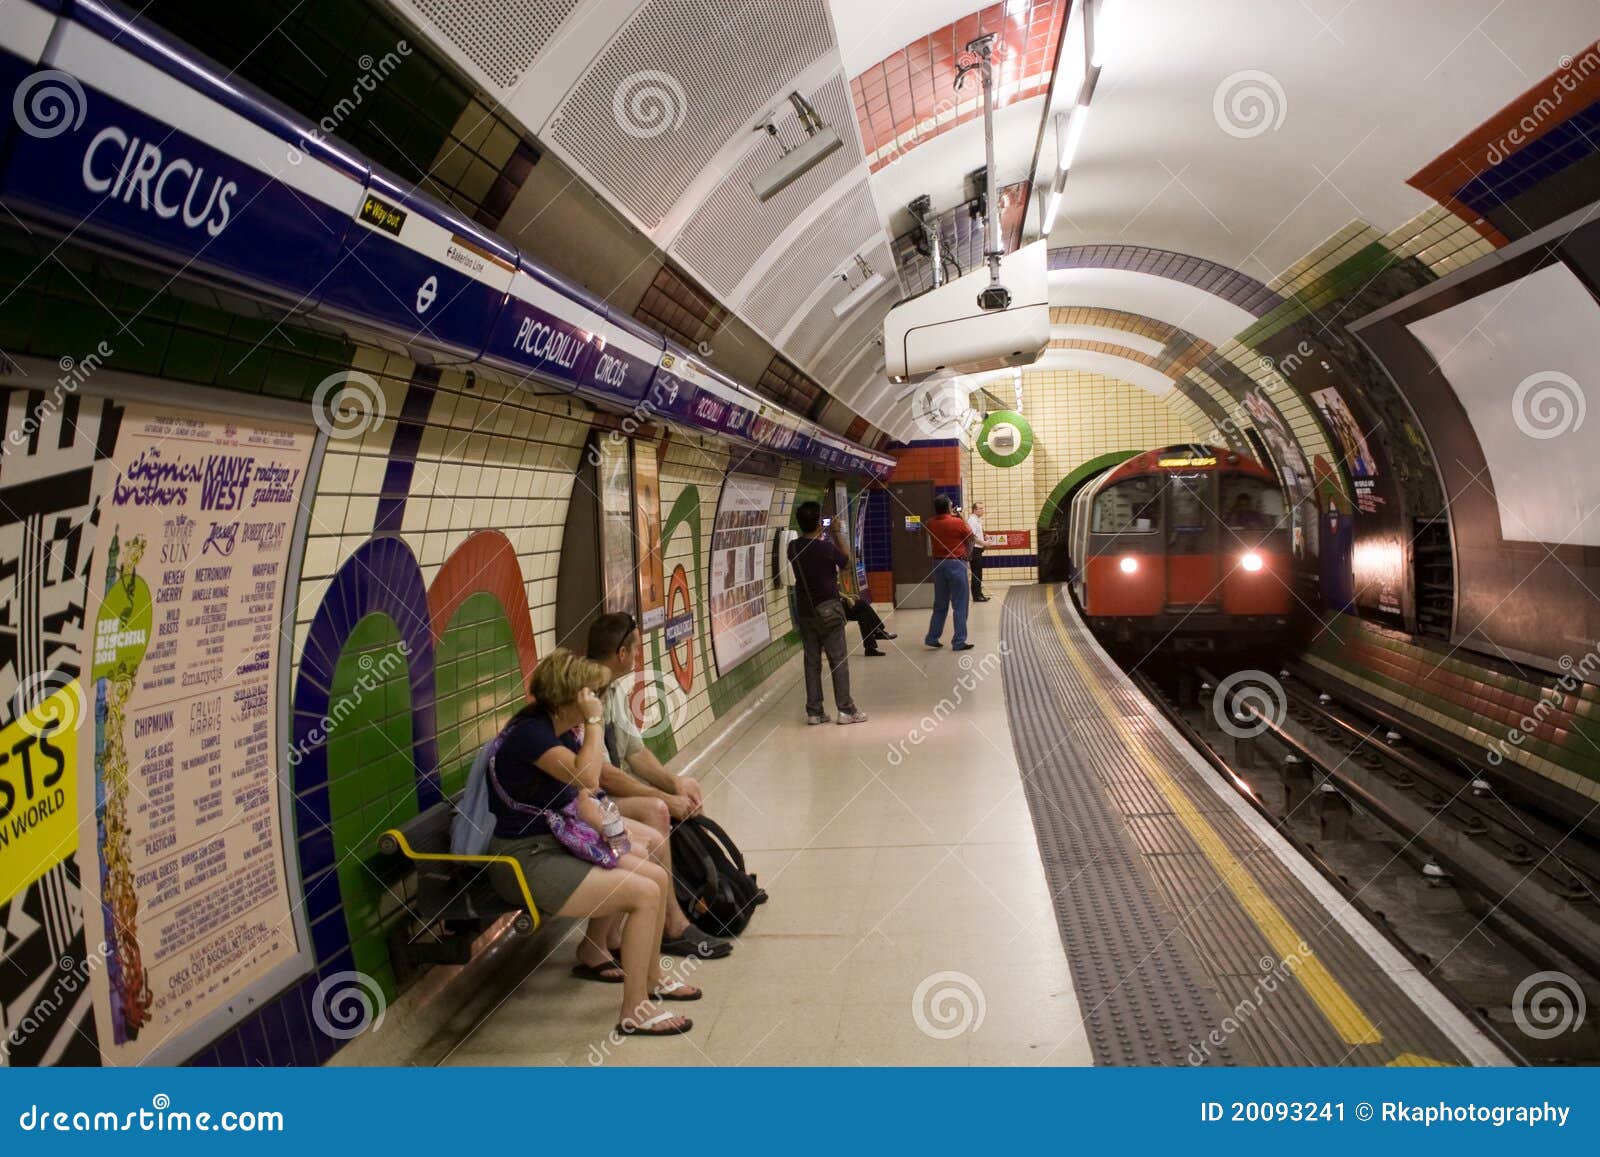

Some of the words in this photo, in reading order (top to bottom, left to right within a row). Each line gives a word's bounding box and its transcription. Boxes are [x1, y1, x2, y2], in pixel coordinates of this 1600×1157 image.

[82, 126, 238, 237] CIRCUS
[372, 202, 387, 220] Way
[386, 213, 400, 228] out
[513, 316, 585, 369] PICCADILLY
[594, 353, 629, 387] CIRCUS
[204, 455, 254, 482] KANYE
[200, 480, 249, 510] WEST
[160, 543, 190, 563] SUN
[163, 570, 185, 586] NENEH
[157, 587, 183, 603] CHERRY
[191, 696, 222, 720] CALVIN
[134, 710, 174, 738] CHIPMUNK
[189, 714, 222, 736] HARRIS
[11, 788, 64, 839] WORLD
[145, 833, 176, 856] PLASTICIAN
[169, 966, 189, 989] CHECK
[192, 957, 206, 974] OUT
